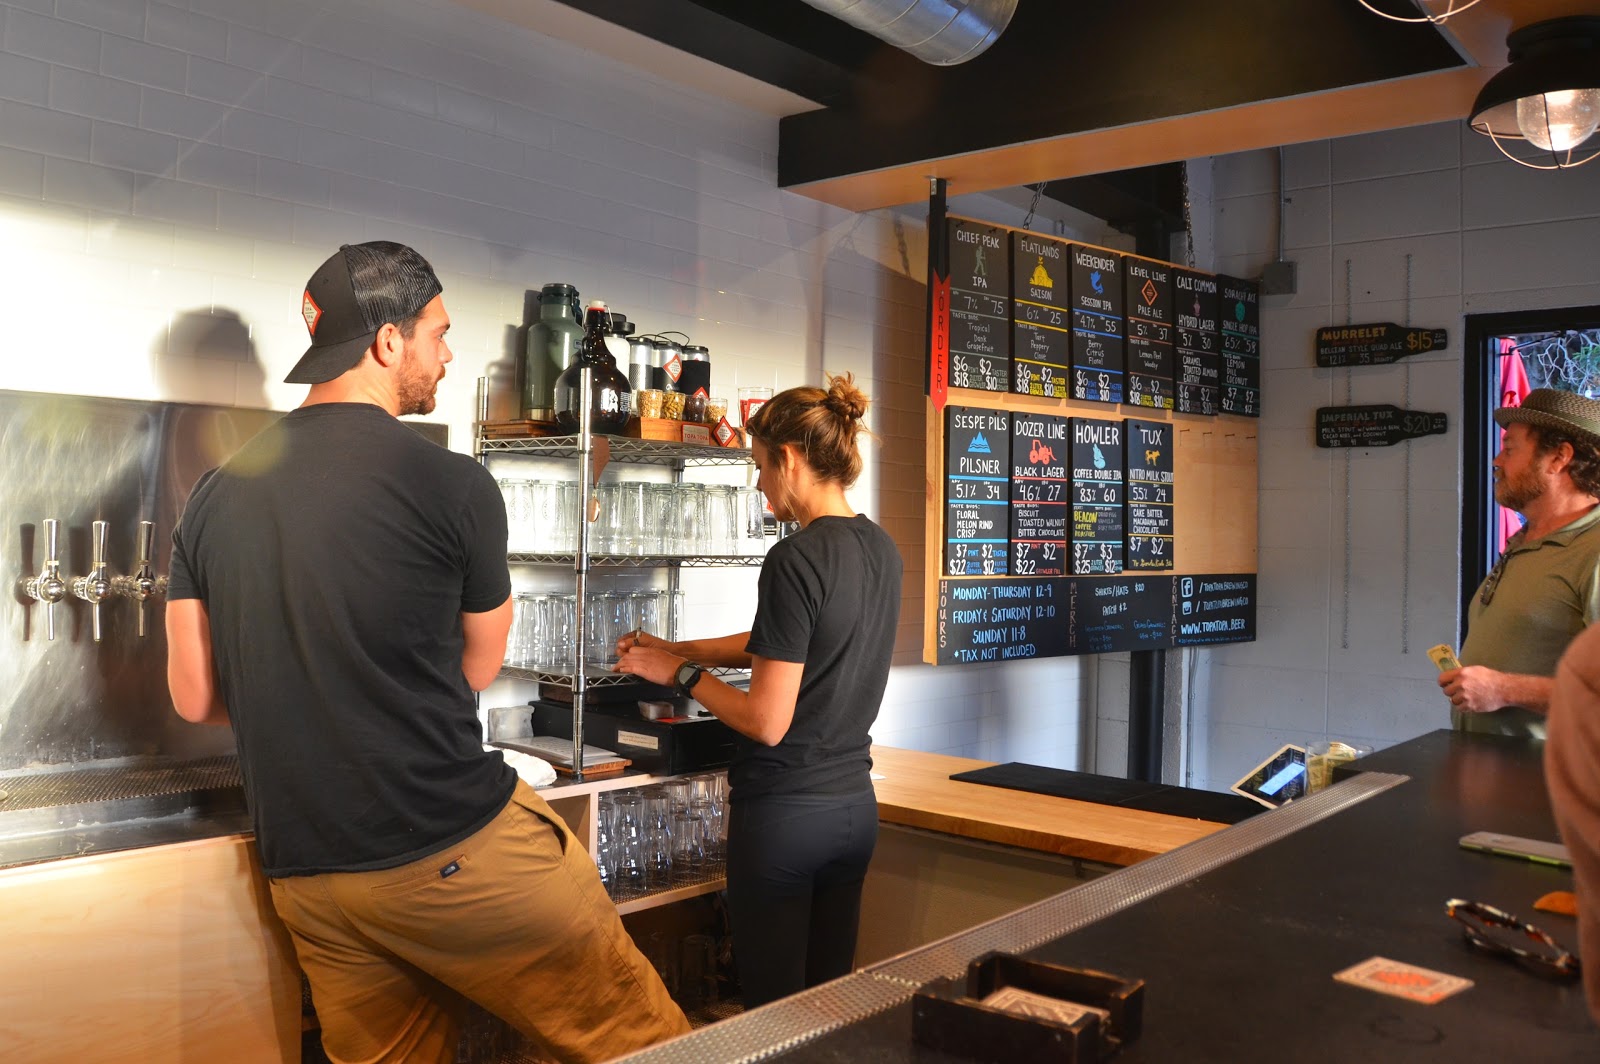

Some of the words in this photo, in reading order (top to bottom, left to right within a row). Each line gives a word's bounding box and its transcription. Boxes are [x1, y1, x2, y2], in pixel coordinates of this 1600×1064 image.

[956, 229, 980, 244] CHIEF
[982, 235, 1000, 249] PEAK
[1021, 240, 1060, 259] FLATLANDS
[1075, 252, 1115, 273] WEEKENDER
[972, 276, 988, 289] IPA
[1130, 266, 1149, 279] LEVEL
[1152, 271, 1167, 283] LINE
[1176, 276, 1193, 290] CALI
[1194, 279, 1217, 294] COMMON
[1030, 287, 1052, 301] SAISON
[964, 296, 978, 310] 7%
[991, 300, 1004, 315] 75
[1081, 295, 1101, 309] SESSION
[1103, 300, 1112, 311] IPA
[1137, 304, 1151, 317] PALE
[1152, 308, 1163, 319] ALE
[1026, 306, 1039, 320] 6%
[1050, 311, 1062, 325] 25
[1178, 314, 1198, 328] HYBRID
[1199, 318, 1215, 331] LAGER
[967, 322, 991, 334] Tropical
[1105, 320, 1117, 333] 55
[1137, 324, 1148, 336] 5%
[1159, 327, 1168, 340] 37
[1321, 326, 1387, 341] MURRELET
[936, 296, 945, 389] ORDER
[966, 340, 994, 353] Grapefruit
[973, 334, 988, 343] Dank
[1088, 339, 1102, 349] Berry
[1182, 333, 1193, 347] 5%
[1201, 337, 1212, 350] 30
[1406, 331, 1433, 351] $15
[1086, 348, 1105, 357] Citrus
[1320, 346, 1346, 355] BELGIAN
[1348, 344, 1369, 353] STYLE
[1370, 343, 1389, 351] QUAD
[1389, 341, 1403, 350] ALE
[953, 354, 969, 372] $6
[979, 357, 992, 376] $2
[1088, 356, 1104, 366] Floral
[1182, 355, 1202, 367] CARAMEL
[1226, 358, 1246, 370] LEMON
[1016, 362, 1031, 379] $6
[1041, 366, 1052, 383] $2
[1183, 365, 1201, 376] TOASTED
[953, 371, 969, 388] $18
[985, 375, 998, 390] $10
[1016, 378, 1030, 394] $18
[1044, 382, 1054, 397] $10
[1076, 369, 1089, 387] $6
[1098, 372, 1110, 390] $2
[1130, 375, 1142, 391] $6
[1150, 379, 1160, 394] $2
[1075, 384, 1086, 399] $18
[1099, 389, 1110, 402] $10
[1129, 390, 1141, 406] $18
[1153, 394, 1164, 408] $10
[1179, 384, 1189, 399] $6
[1200, 387, 1210, 402] $2
[1227, 387, 1238, 400] $7
[1245, 390, 1254, 404] $2
[1179, 398, 1191, 412] $18
[1222, 397, 1234, 411] $22
[954, 414, 986, 430] SESPE
[988, 416, 1007, 431] PILS
[1321, 412, 1370, 423] IMPERIAL
[1372, 410, 1394, 419] TUX
[1402, 415, 1431, 434] $20
[1015, 420, 1045, 438] DOZER
[1047, 423, 1066, 440] LINE
[1075, 424, 1119, 446] HOWLER
[1140, 428, 1162, 446] TUX
[1321, 426, 1336, 434] MILK
[1322, 432, 1339, 440] CACAO
[960, 456, 1001, 475] PILSNER
[1015, 465, 1038, 477] BLACK
[1041, 466, 1065, 478] LAGER
[1073, 468, 1093, 479] COFFEE
[1094, 469, 1112, 480] DOUBLE
[1113, 470, 1122, 481] IPA
[1129, 468, 1146, 480] NITRO
[1145, 470, 1160, 482] MILK
[956, 483, 977, 498] 5.1%
[986, 485, 1000, 500] 34
[1047, 484, 1061, 501] 27
[1103, 488, 1116, 503] 60
[1155, 487, 1167, 503] 24
[956, 510, 980, 520] FLORAL
[1018, 509, 1040, 518] BISCUIT
[1073, 510, 1098, 524] BEACON
[1132, 517, 1157, 527] MACADAMIA
[1158, 519, 1169, 527] NUT
[1133, 508, 1145, 517] CAKE
[1146, 508, 1163, 519] BATTER
[956, 520, 977, 529] MELON
[979, 520, 994, 530] RIND
[1018, 518, 1045, 527] TOASTED
[1045, 518, 1066, 527] WALNUT
[1132, 525, 1160, 535] CHOCOLATE
[956, 528, 976, 539] CRISP
[1017, 528, 1037, 538] BITTER
[1038, 528, 1065, 537] CHOCOLATE
[956, 543, 968, 558] $7
[967, 549, 979, 557] PINT
[981, 543, 993, 559] $2
[1016, 542, 1031, 559] $7
[1042, 542, 1057, 560] $2
[1074, 542, 1089, 560] $7
[1100, 542, 1113, 560] $3
[1130, 536, 1142, 552] $7
[1150, 536, 1164, 555] $2
[949, 558, 967, 576] $22
[983, 558, 995, 576] $12
[1015, 558, 1036, 575] $22
[1074, 559, 1091, 575] $25
[1104, 559, 1116, 574] $12
[992, 585, 1032, 600] THURSDAY
[1036, 583, 1052, 598] 12-9
[940, 580, 948, 649] HOURS
[991, 605, 1032, 623] SATURDAY
[1035, 605, 1056, 619] 12-10
[1069, 582, 1077, 648] MERCH
[1102, 604, 1117, 616] PATCH
[1118, 602, 1128, 613] $2
[972, 627, 1008, 645] SUNDAY
[1011, 625, 1026, 642] 11-8
[1180, 618, 1246, 635] WWW.TOPATOPA.BEER
[981, 646, 998, 661] NOT
[1002, 643, 1036, 659] INCLUDED
